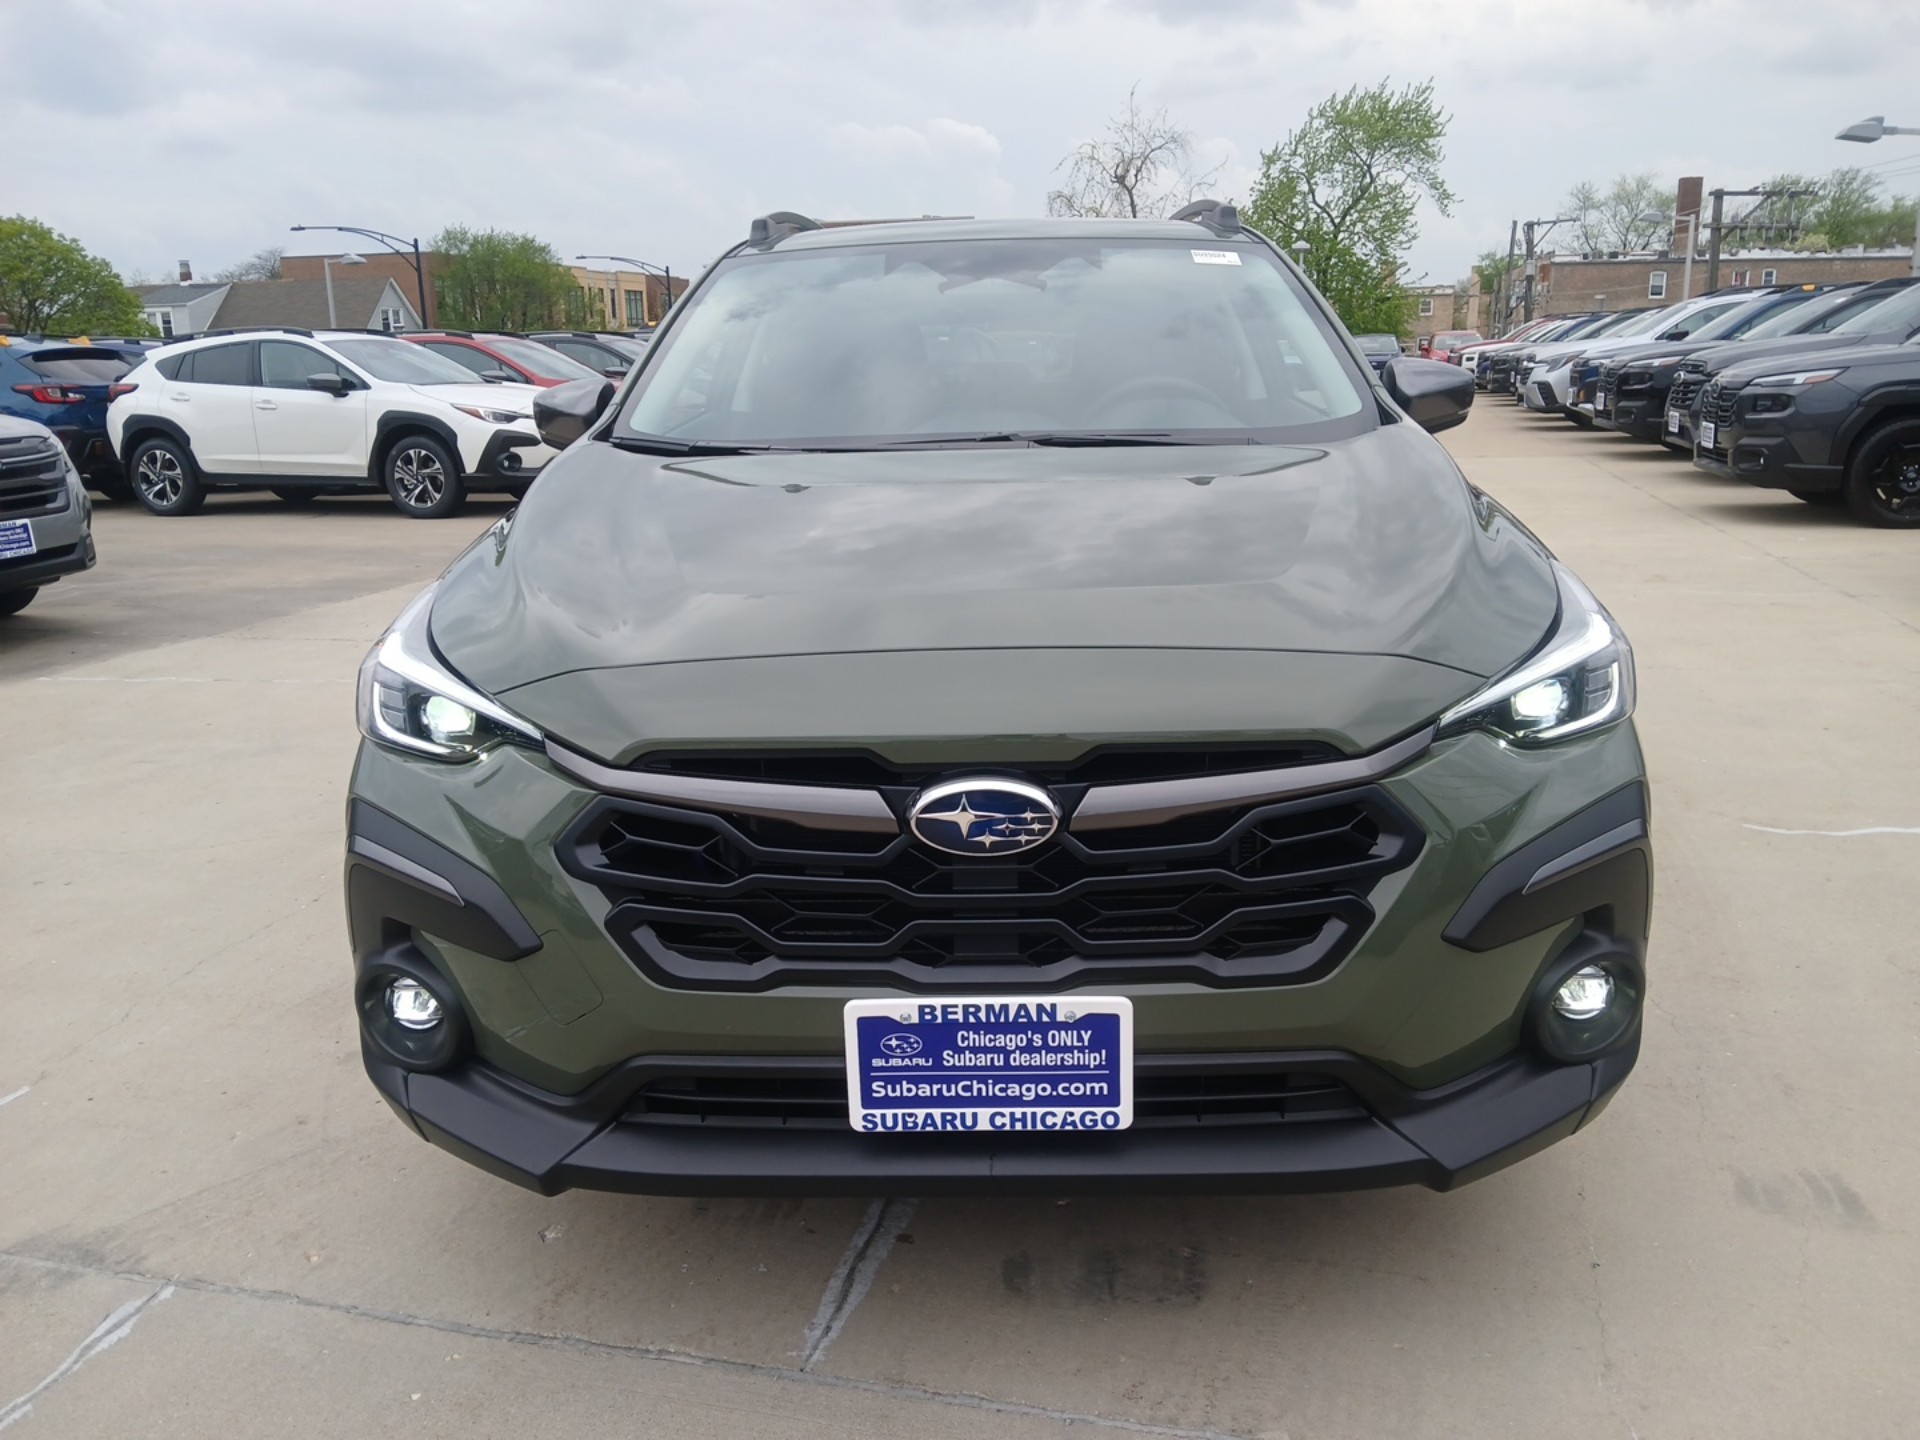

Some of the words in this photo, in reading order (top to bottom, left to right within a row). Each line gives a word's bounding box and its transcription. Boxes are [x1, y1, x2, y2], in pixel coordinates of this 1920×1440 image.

[917, 1003, 1057, 1024] BERMAN
[957, 1030, 1043, 1049] Chicago's
[1047, 1030, 1092, 1046] ONLY
[871, 1058, 932, 1067] SUBARU
[942, 1049, 1004, 1067] Subaru
[1009, 1049, 1106, 1068] dealership!
[871, 1080, 1109, 1100] SubaruChicago.com
[861, 1112, 978, 1132] SUBARU
[988, 1111, 1121, 1131] CHICAGO
